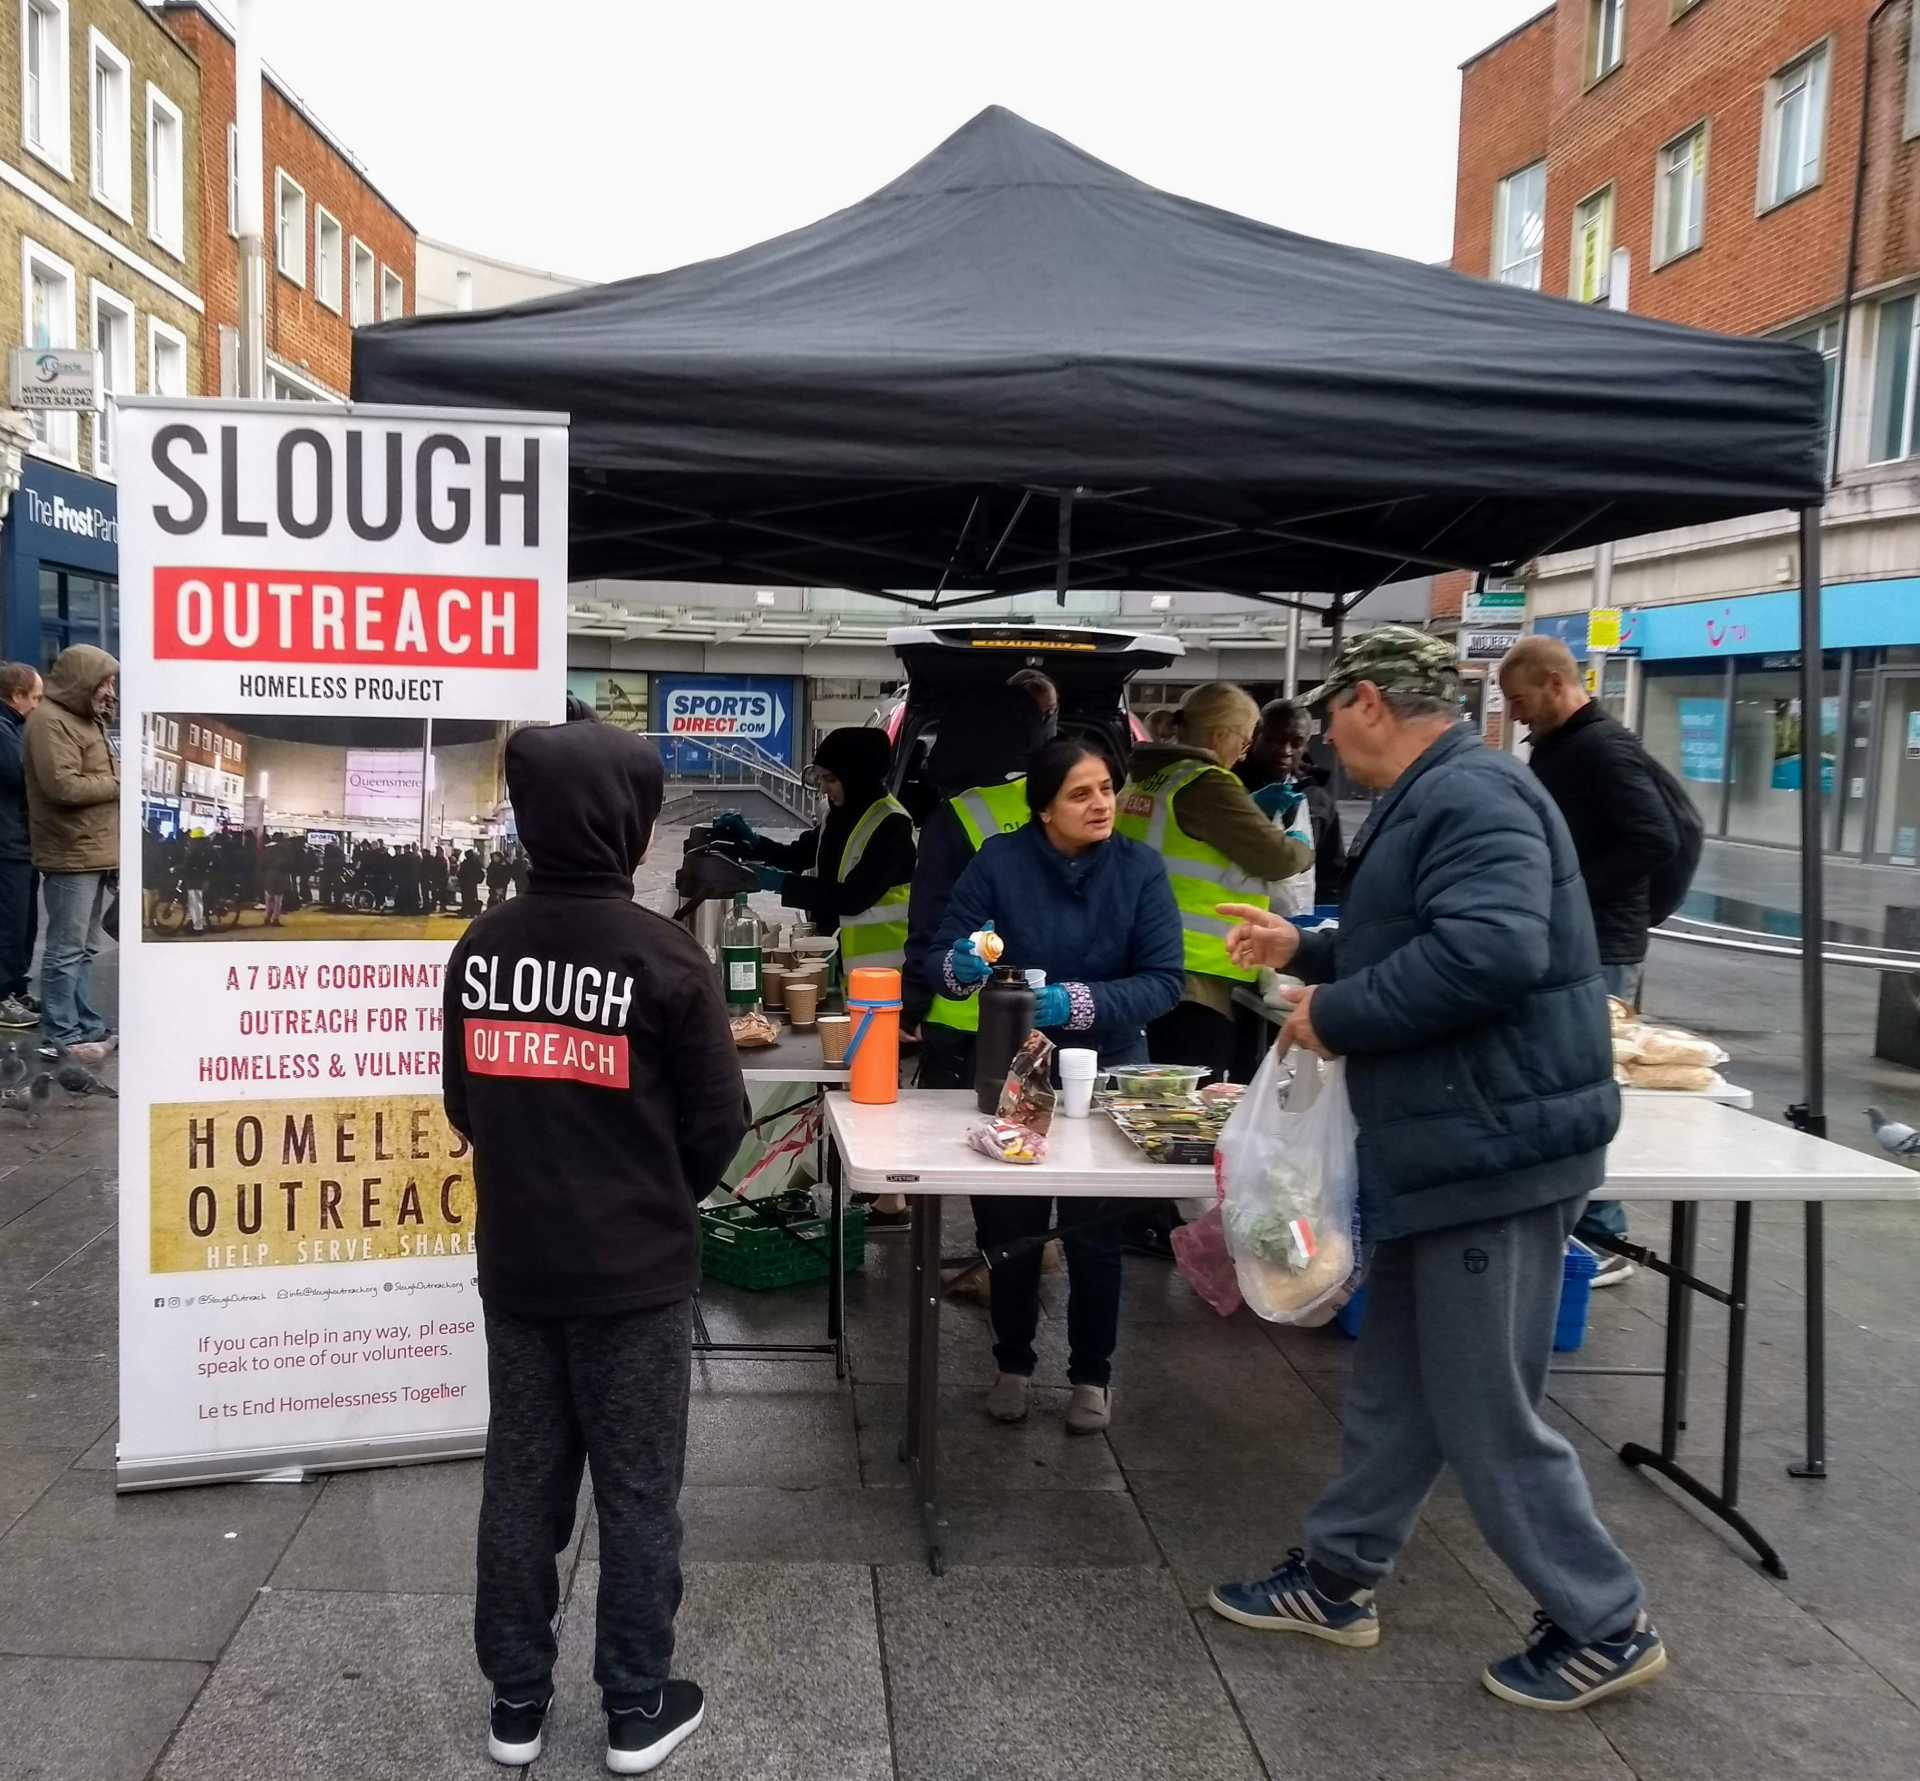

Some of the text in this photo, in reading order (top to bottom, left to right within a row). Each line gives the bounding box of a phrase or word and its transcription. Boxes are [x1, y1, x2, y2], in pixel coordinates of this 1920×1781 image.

[22, 385, 93, 396] NURSING AGENCY
[151, 423, 540, 548] SLOUGH
[176, 579, 516, 656] OUTREACH
[239, 674, 444, 702] HOMELESS PROJECT
[673, 695, 766, 717] SPORTS
[349, 774, 423, 793] Queensmere
[226, 964, 448, 991] A 7 DAY COORDINAT
[461, 955, 634, 1027] SLOUGH
[240, 1007, 443, 1035] OUTREACH FOR TH
[199, 1051, 441, 1082] HOMELESS & VULNER
[473, 1028, 615, 1076] OUTREACH
[188, 1174, 463, 1237] OUTREAC
[207, 1243, 280, 1269] HELP.
[298, 1237, 384, 1263] SERVE.
[199, 1337, 211, 1353] If
[213, 1338, 246, 1355] you
[249, 1335, 279, 1349] can
[283, 1329, 319, 1351] help
[324, 1328, 338, 1343] in
[342, 1328, 372, 1345] any
[375, 1324, 411, 1343] way,
[198, 1343, 453, 1378] speak to one of our volunteers.
[242, 1397, 275, 1416] End
[280, 1390, 398, 1413] Homelessness
